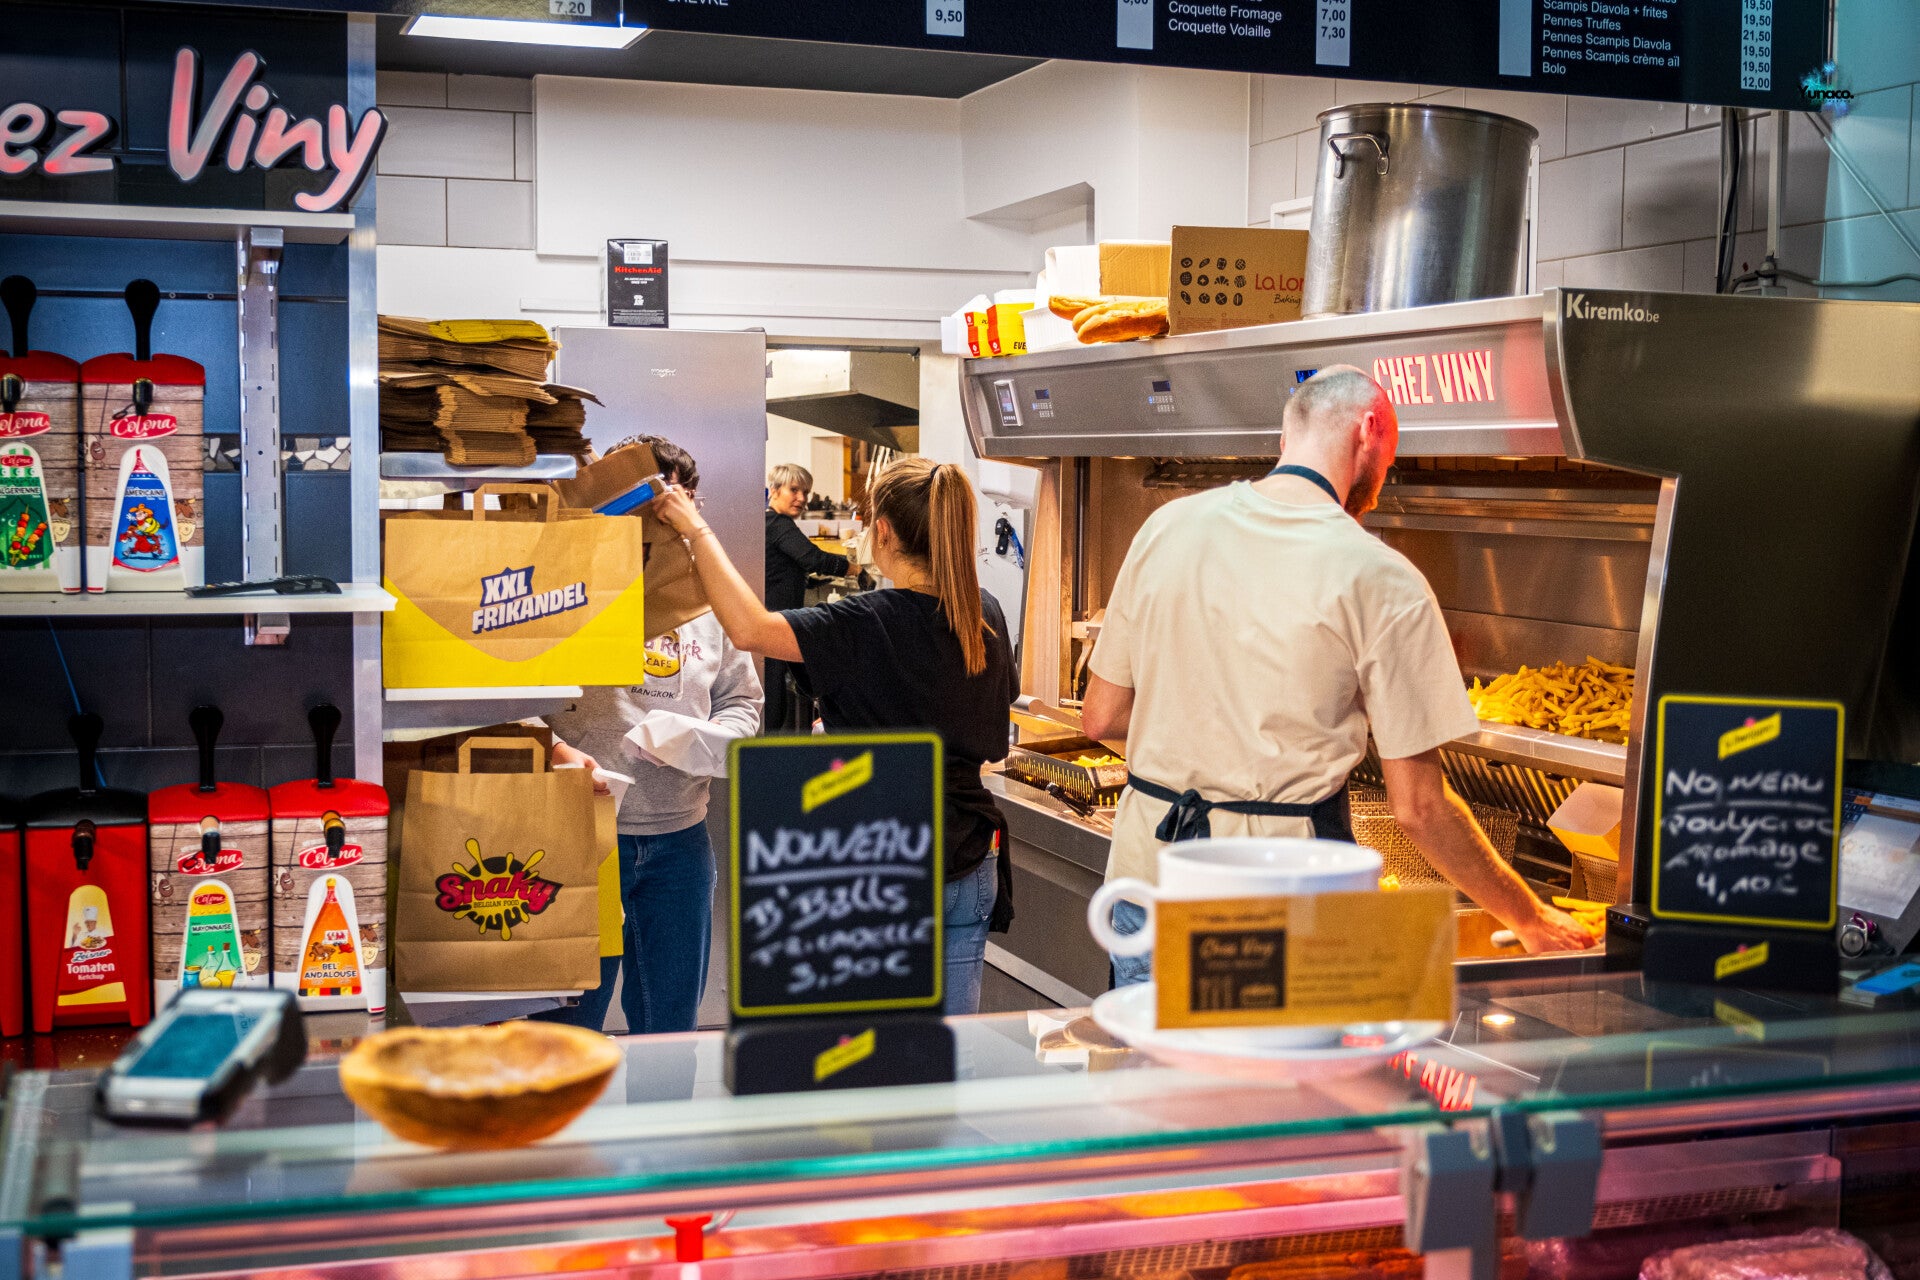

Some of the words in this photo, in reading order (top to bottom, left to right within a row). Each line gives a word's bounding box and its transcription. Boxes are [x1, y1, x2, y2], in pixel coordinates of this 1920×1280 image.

[1168, 1, 1227, 17] Croquette
[1230, 6, 1282, 23] Fromage
[1543, 0, 1588, 13] Scampis
[1591, 1, 1630, 15] Diavola
[1642, 5, 1668, 19] frites
[1744, 0, 1772, 11] 19,50
[935, 9, 963, 23] 9,50
[1321, 9, 1346, 22] 7,00
[1543, 13, 1583, 27] Pennes
[1586, 17, 1622, 31] Truffes
[1743, 14, 1771, 27] 19,50
[1168, 18, 1227, 35] Croquette
[1230, 23, 1271, 38] Volaille
[1320, 26, 1346, 39] 7,30
[1743, 29, 1771, 42] 21,50
[1543, 29, 1583, 43] Pennes
[1586, 33, 1630, 48] Scampis
[1633, 36, 1672, 50] Diavola
[1542, 45, 1583, 60] Pennes
[1586, 49, 1630, 64] Scampis
[1633, 53, 1665, 67] crème
[1743, 45, 1770, 58] 19,50
[1542, 61, 1567, 74] Bolo
[1743, 61, 1770, 74] 19,50
[1743, 77, 1770, 89] 12,00
[0, 102, 116, 174] ez
[167, 47, 387, 211] Viny
[614, 266, 662, 274] KitchenAid
[1255, 273, 1275, 291] La
[1373, 354, 1434, 405] CHEZ
[1431, 349, 1495, 403] VINY
[0, 413, 49, 434] olona
[114, 415, 176, 437] Colona
[483, 570, 529, 605] XXL
[471, 581, 587, 634] FRIKANDEL
[630, 686, 676, 699] BANGKOK
[747, 817, 933, 874] NOUVEAU
[182, 852, 242, 874] olna
[302, 845, 361, 867] Colna
[436, 870, 557, 914] Snaky
[473, 900, 502, 908] BELGIAN
[192, 923, 232, 932] MAYONNAISE
[66, 962, 115, 974] Tomaten
[304, 970, 357, 979] ANDALOUSE
